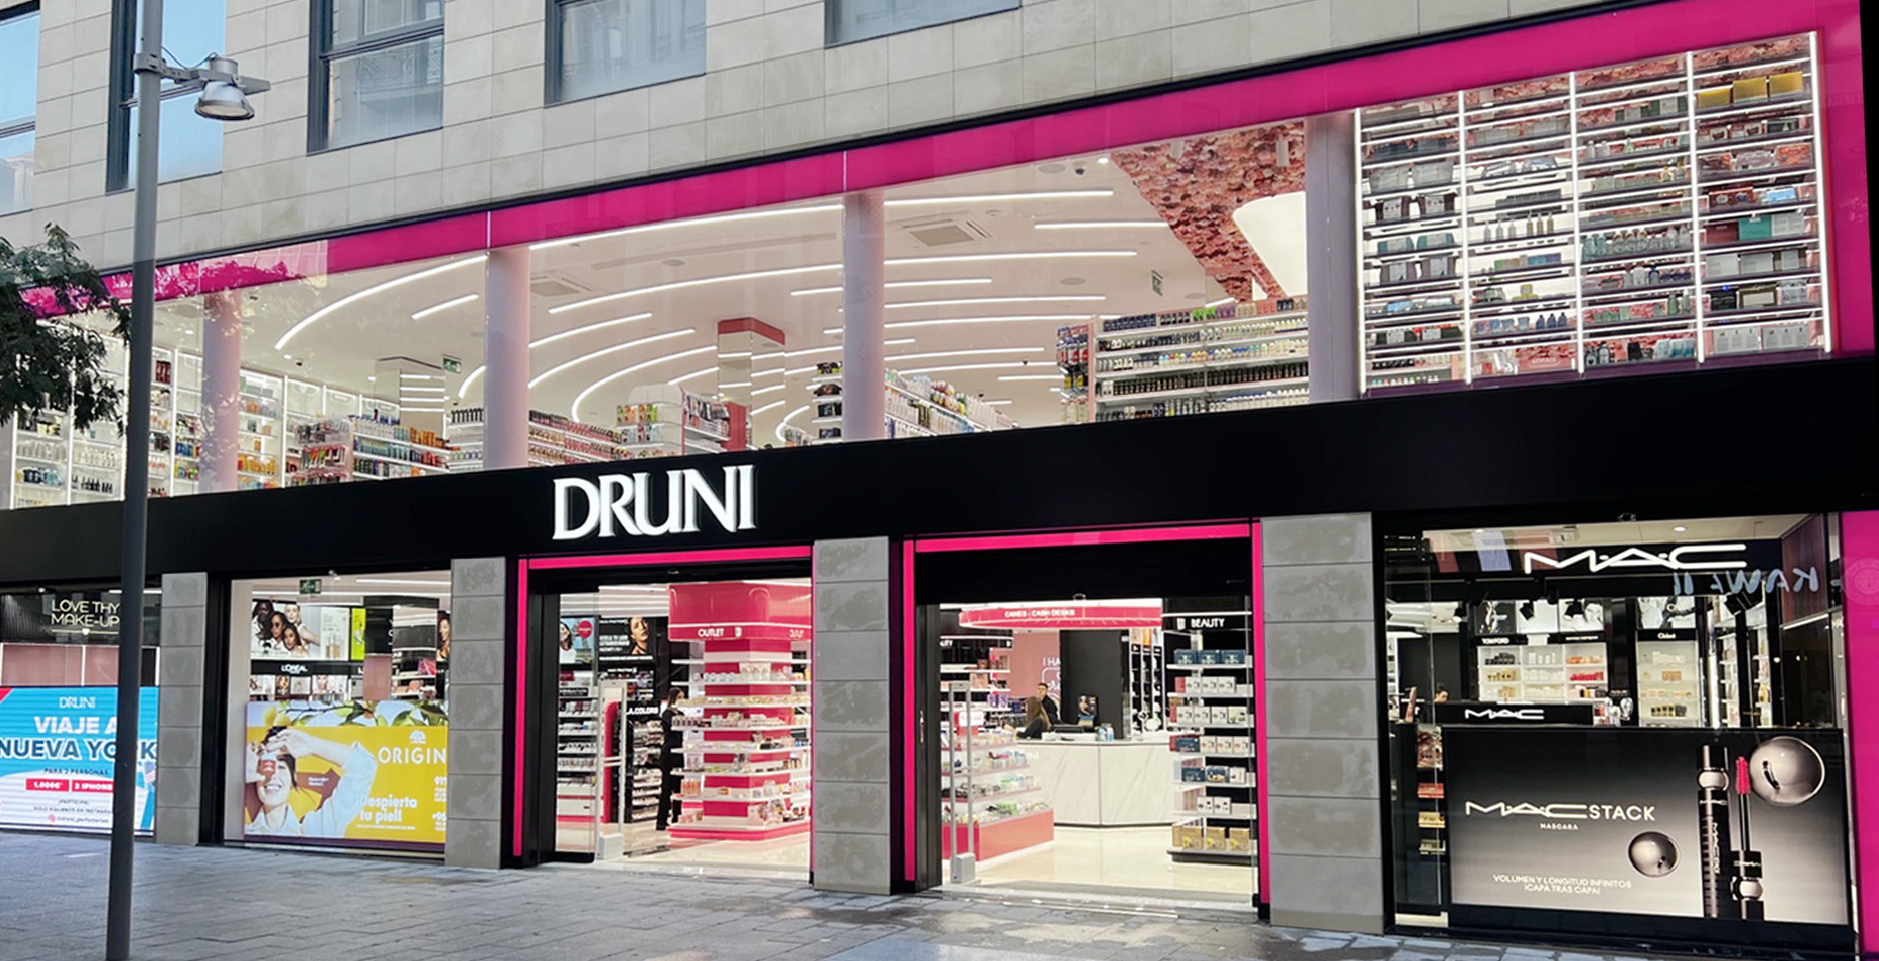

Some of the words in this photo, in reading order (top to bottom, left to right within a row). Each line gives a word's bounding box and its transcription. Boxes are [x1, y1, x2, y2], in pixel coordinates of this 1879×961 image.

[552, 464, 757, 540] DRUNI
[51, 599, 90, 613] LOVE
[92, 601, 121, 614] THY
[51, 612, 120, 627] MAKE-UP
[1191, 618, 1225, 628] BEAUTY
[698, 628, 724, 638] OUTLET
[59, 696, 96, 709] DRUNI
[33, 716, 100, 735] VIAJE
[0, 737, 82, 761] NUEVA
[84, 738, 158, 762] YOK
[377, 747, 447, 765] ORIGIN
[359, 809, 373, 822] tu
[1589, 804, 1656, 822] STACK
[1540, 823, 1579, 831] MASCARA
[1492, 874, 1535, 884] VOLUMEN
[1535, 876, 1542, 884] Y
[1543, 876, 1589, 887] LONGITUD
[1590, 879, 1632, 889] INFINITOS
[1552, 885, 1573, 893] TRAS
